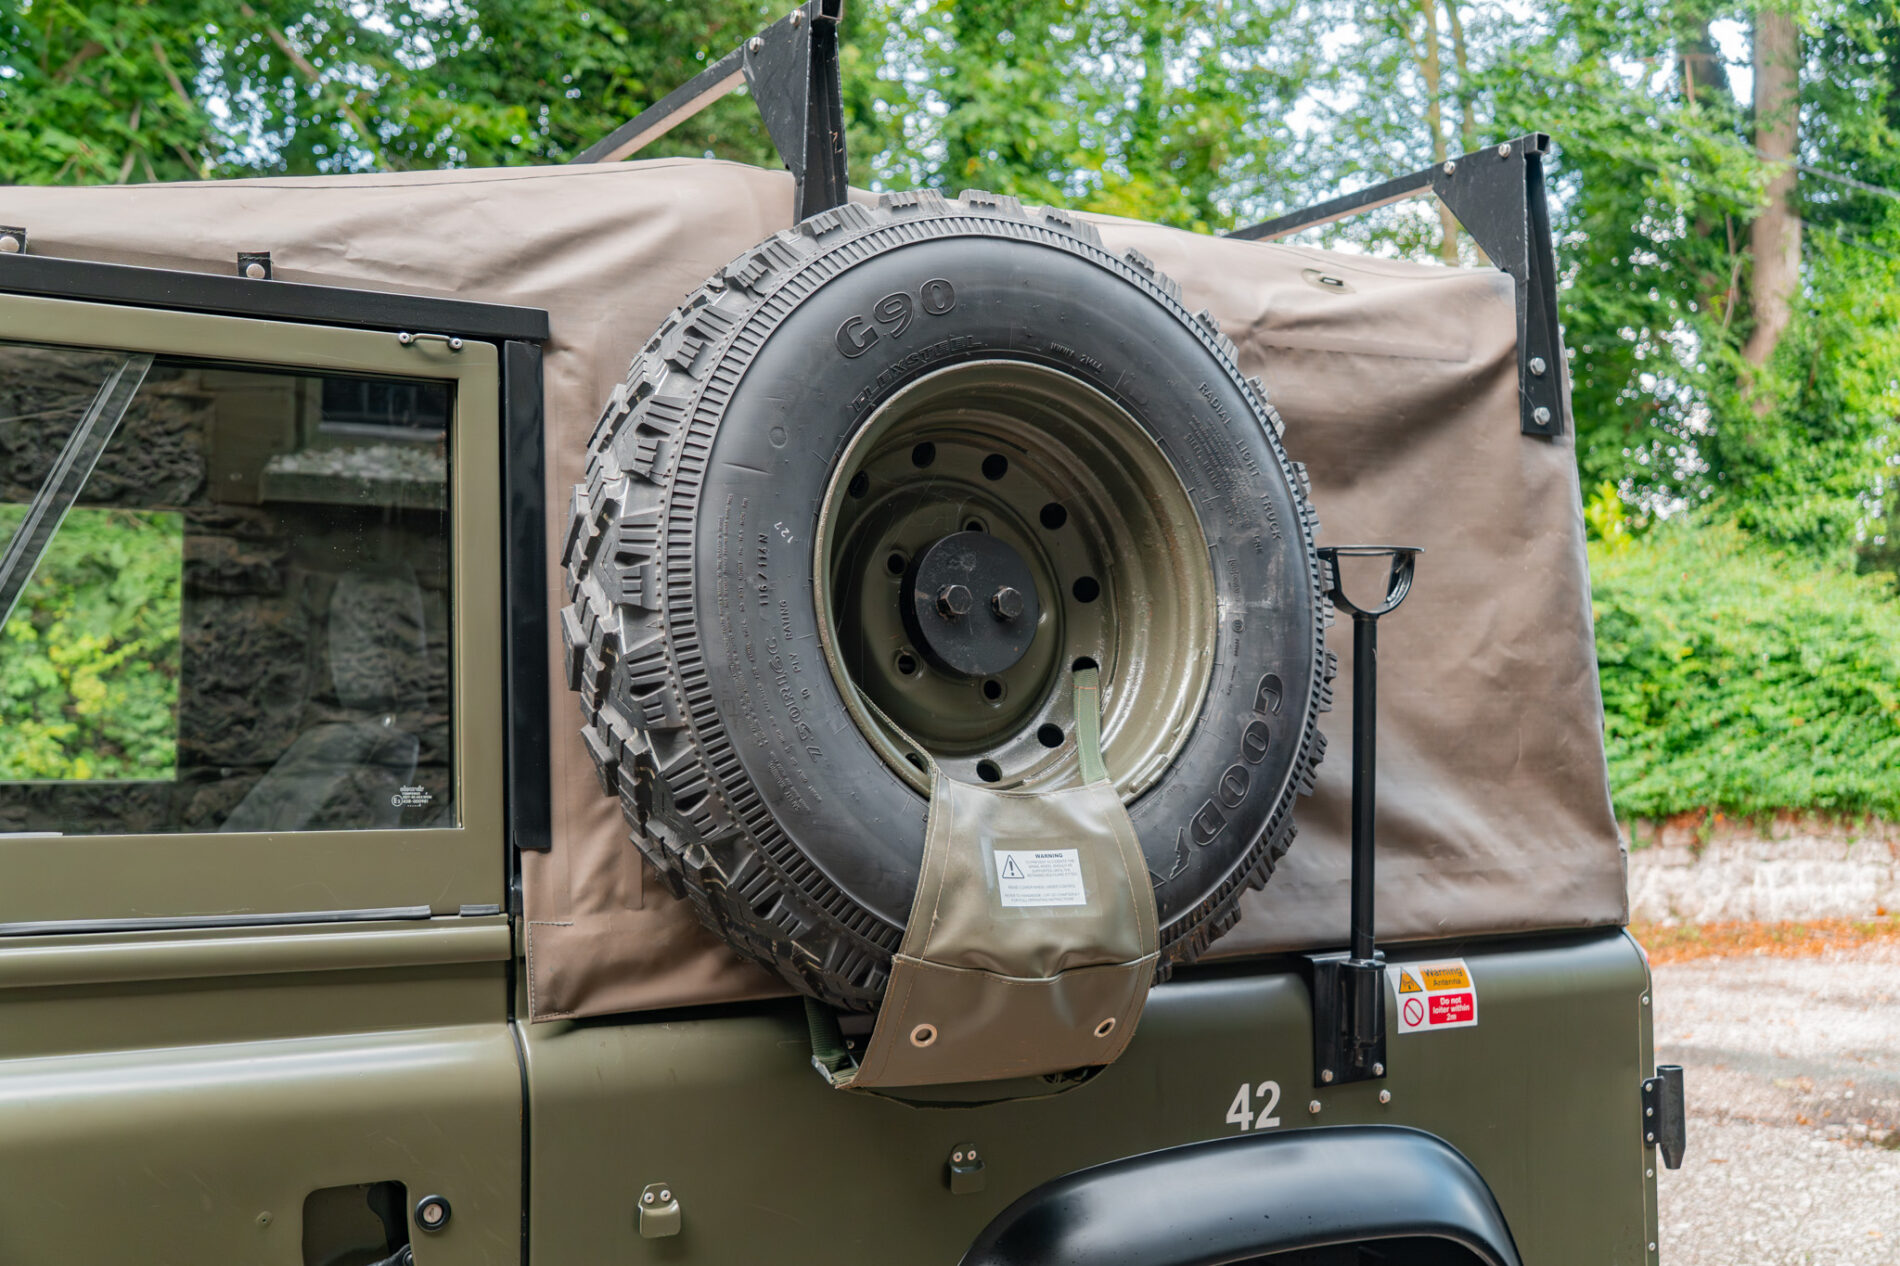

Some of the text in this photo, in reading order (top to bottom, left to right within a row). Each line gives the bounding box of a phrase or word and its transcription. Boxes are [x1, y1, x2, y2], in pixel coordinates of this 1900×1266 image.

[835, 278, 956, 358] G90
[1199, 381, 1232, 429] RADIAL
[1235, 439, 1261, 479] LIGHT
[1260, 493, 1282, 541] TRUCK
[779, 600, 793, 640] RATING
[1423, 967, 1463, 977] Warning
[1440, 996, 1462, 1006] Do not
[1450, 1003, 1470, 1013] within
[1446, 1013, 1457, 1021] 2m
[1225, 1080, 1281, 1131] 42
